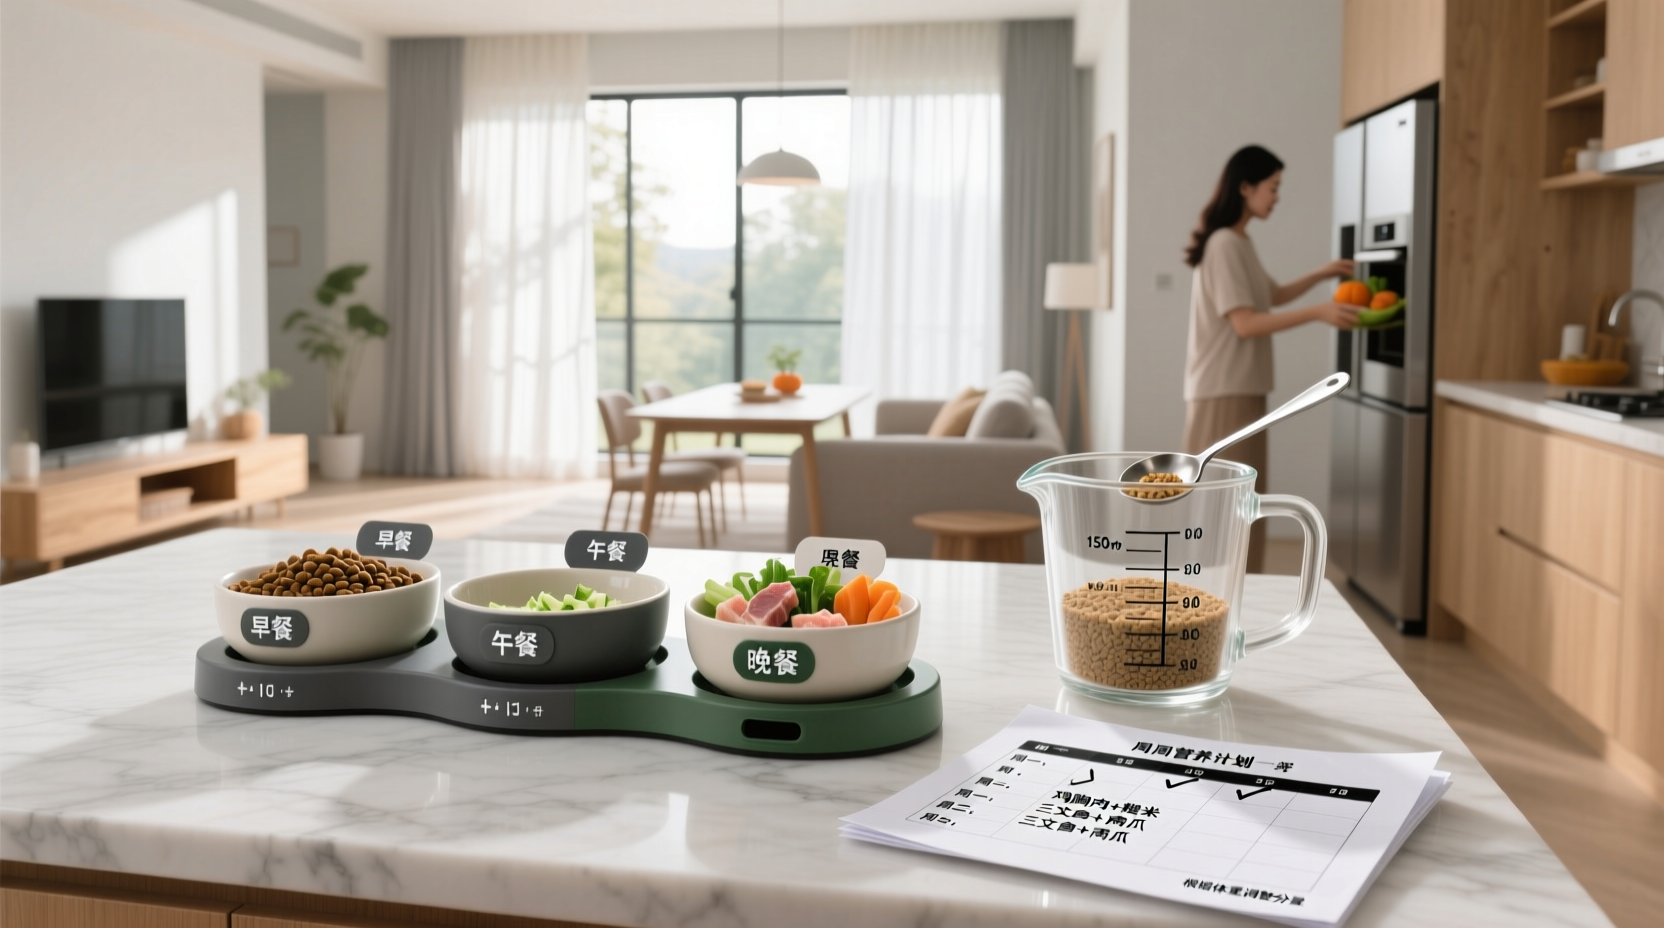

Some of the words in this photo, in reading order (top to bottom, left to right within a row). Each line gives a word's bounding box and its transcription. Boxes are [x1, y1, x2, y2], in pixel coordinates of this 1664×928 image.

[375, 530, 412, 552] 早餐
[586, 539, 627, 562] 午餐
[250, 615, 293, 641] 早餐
[491, 630, 538, 658] 午餐
[746, 646, 799, 676] 晚餐
